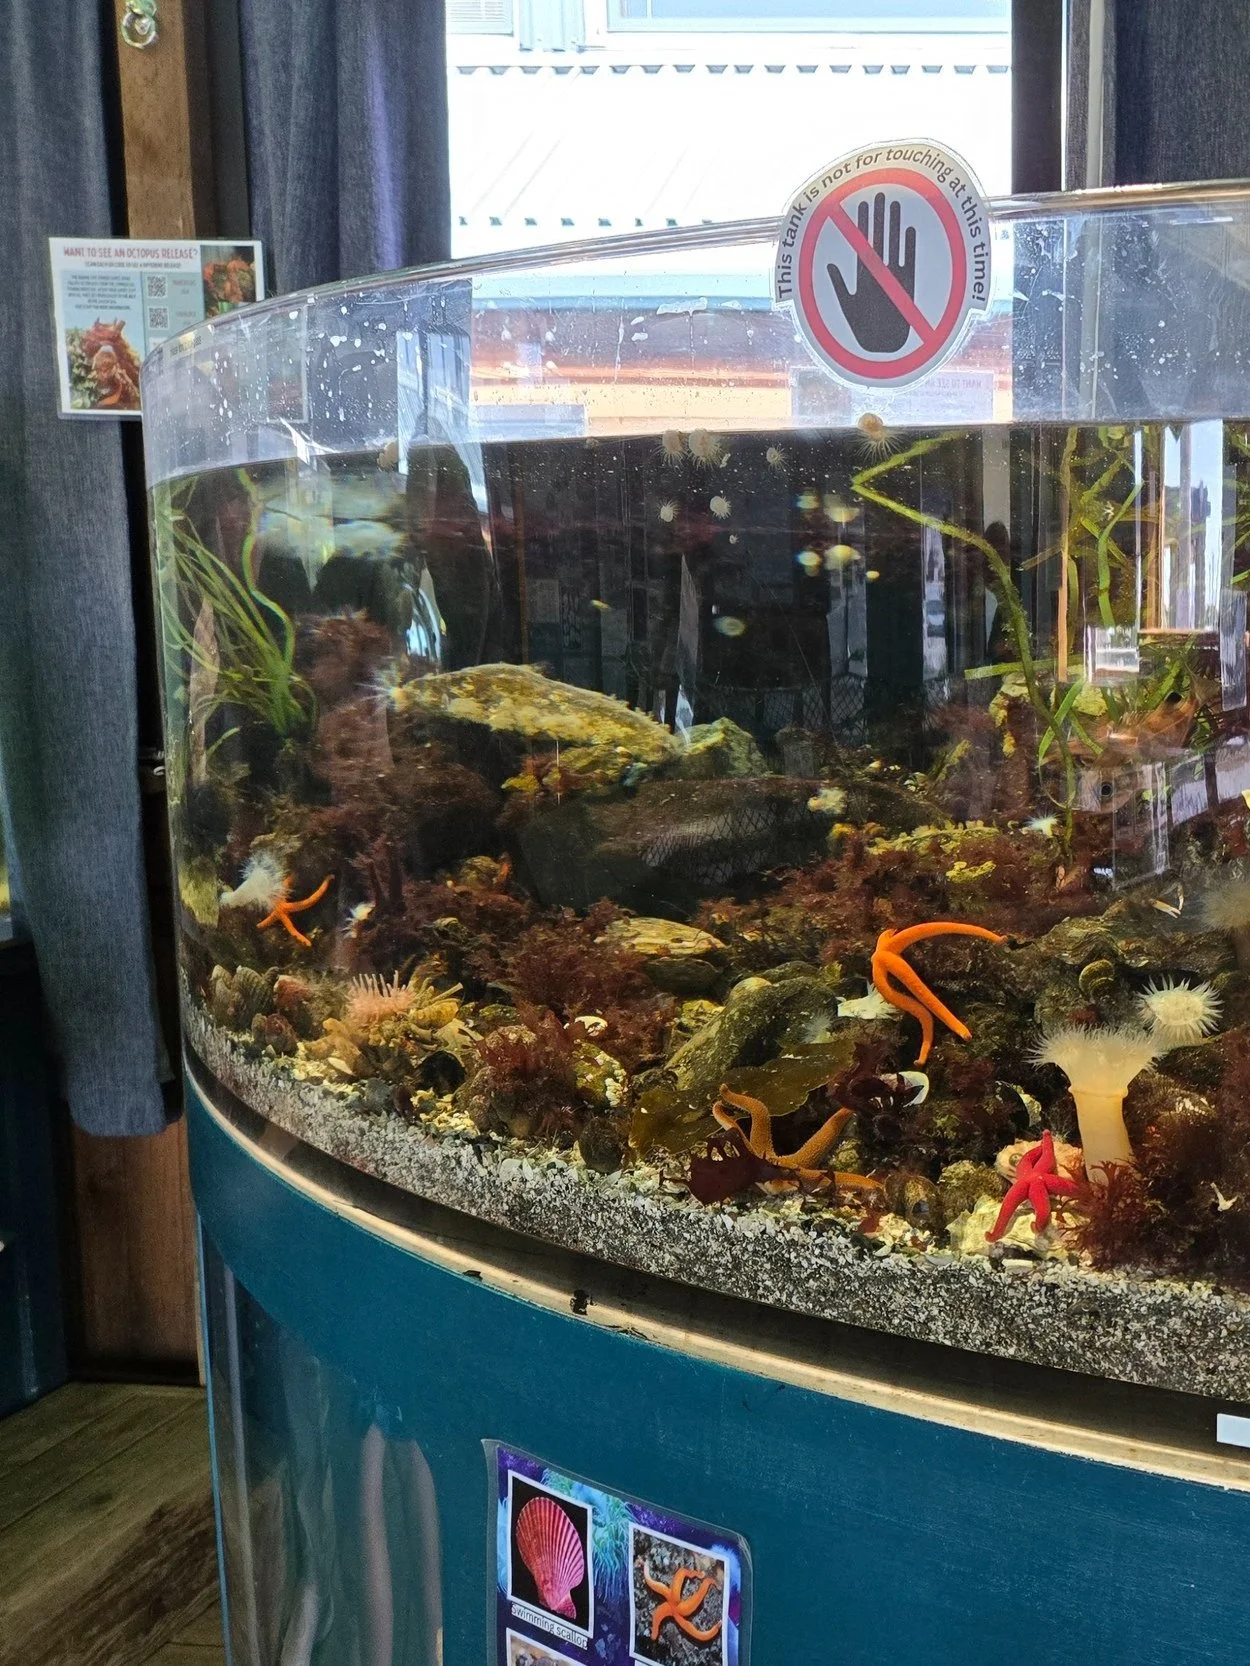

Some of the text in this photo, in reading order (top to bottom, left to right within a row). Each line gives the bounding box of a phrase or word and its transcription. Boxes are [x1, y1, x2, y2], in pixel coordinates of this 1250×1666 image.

[778, 148, 989, 302] This tank is not for touching at this time!
[64, 247, 198, 259] WANT TO SEE AN OCTOPUS RELEASE?
[512, 1604, 588, 1648] Swimming scallop
